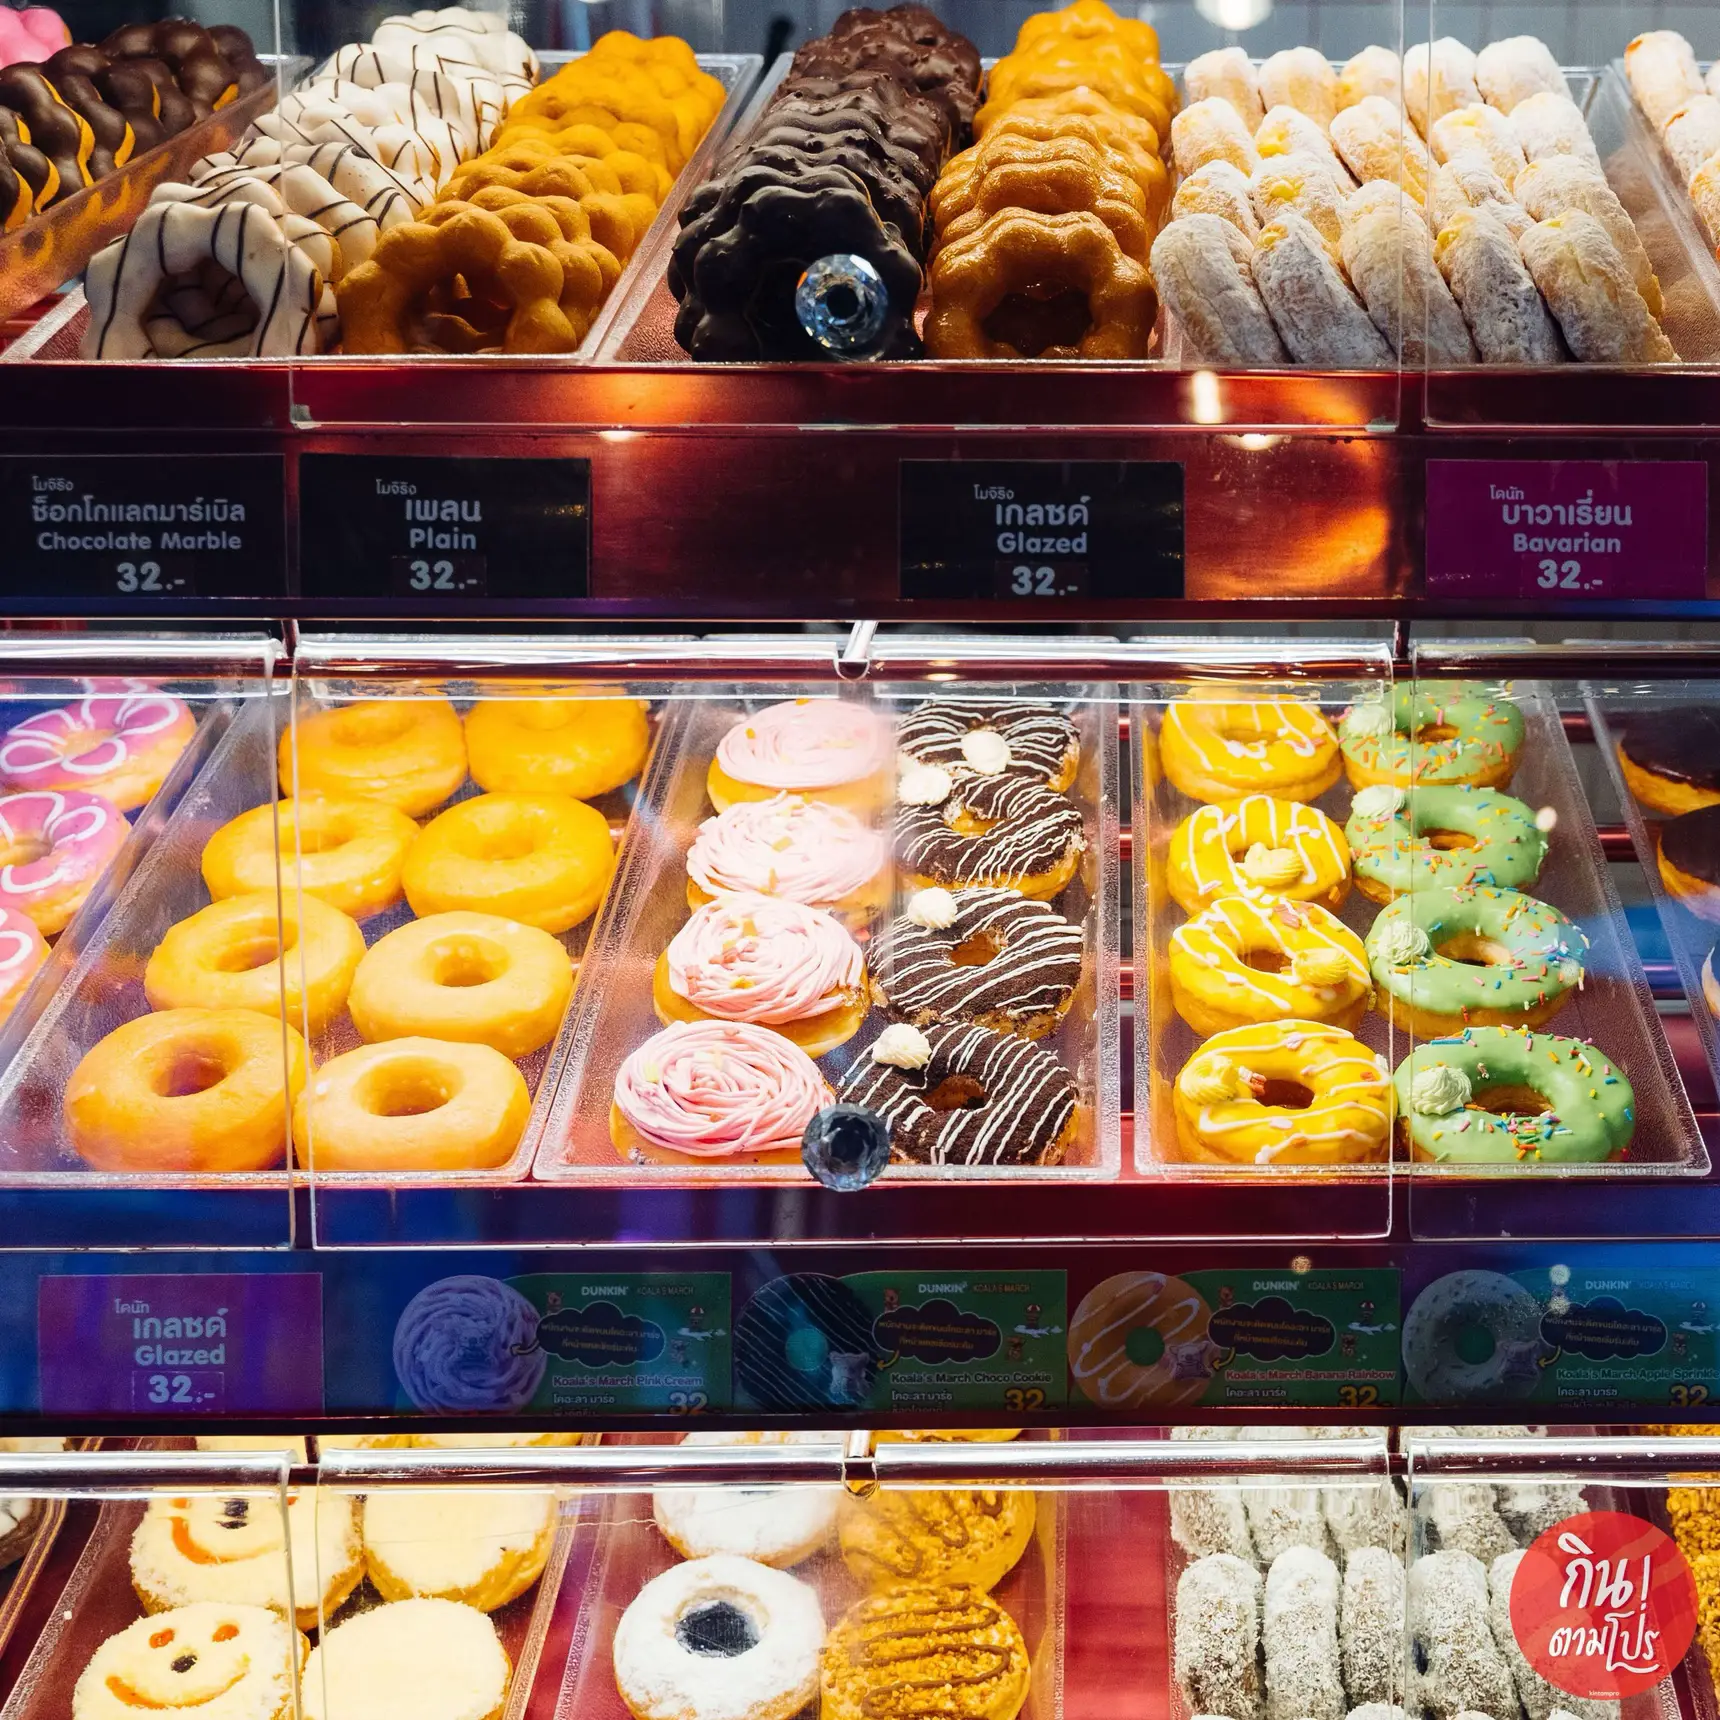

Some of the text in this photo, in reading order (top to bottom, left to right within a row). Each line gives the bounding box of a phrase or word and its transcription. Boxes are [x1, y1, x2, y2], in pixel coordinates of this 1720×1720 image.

[31, 475, 75, 492] โมจิริง
[375, 478, 418, 495] โมจิริง
[973, 484, 1015, 500] โมจิริง
[1489, 484, 1525, 500] โดนัท
[405, 499, 483, 522] เพลน
[1501, 488, 1633, 526] บาวาเรี่ยน
[37, 531, 242, 550] Chocolate Marble
[409, 526, 477, 549] Plain
[997, 532, 1087, 553] Glazed
[1513, 532, 1621, 553] Bavarian
[116, 561, 186, 592] 32.-
[410, 560, 478, 590] 32.-
[1011, 565, 1078, 596] 32.-
[1537, 559, 1603, 590] 32.-
[581, 1286, 629, 1296] DUNKIN'
[918, 1281, 968, 1294] DUNKIN'
[1252, 1281, 1300, 1291] DUNKIN'
[1585, 1280, 1632, 1291] DUNKIN'
[114, 1298, 150, 1314] โดนัท
[135, 1343, 226, 1365] Glazed
[552, 1375, 704, 1387] Koala's March Pink Cream
[891, 1372, 1052, 1384] Koala's March Choco Cookie
[1225, 1370, 1396, 1381] Koala's March Banana Rainbow
[1556, 1369, 1598, 1380] Koala's
[1600, 1369, 1638, 1380] March
[1639, 1369, 1671, 1382] Apple
[148, 1375, 215, 1403] 32.-
